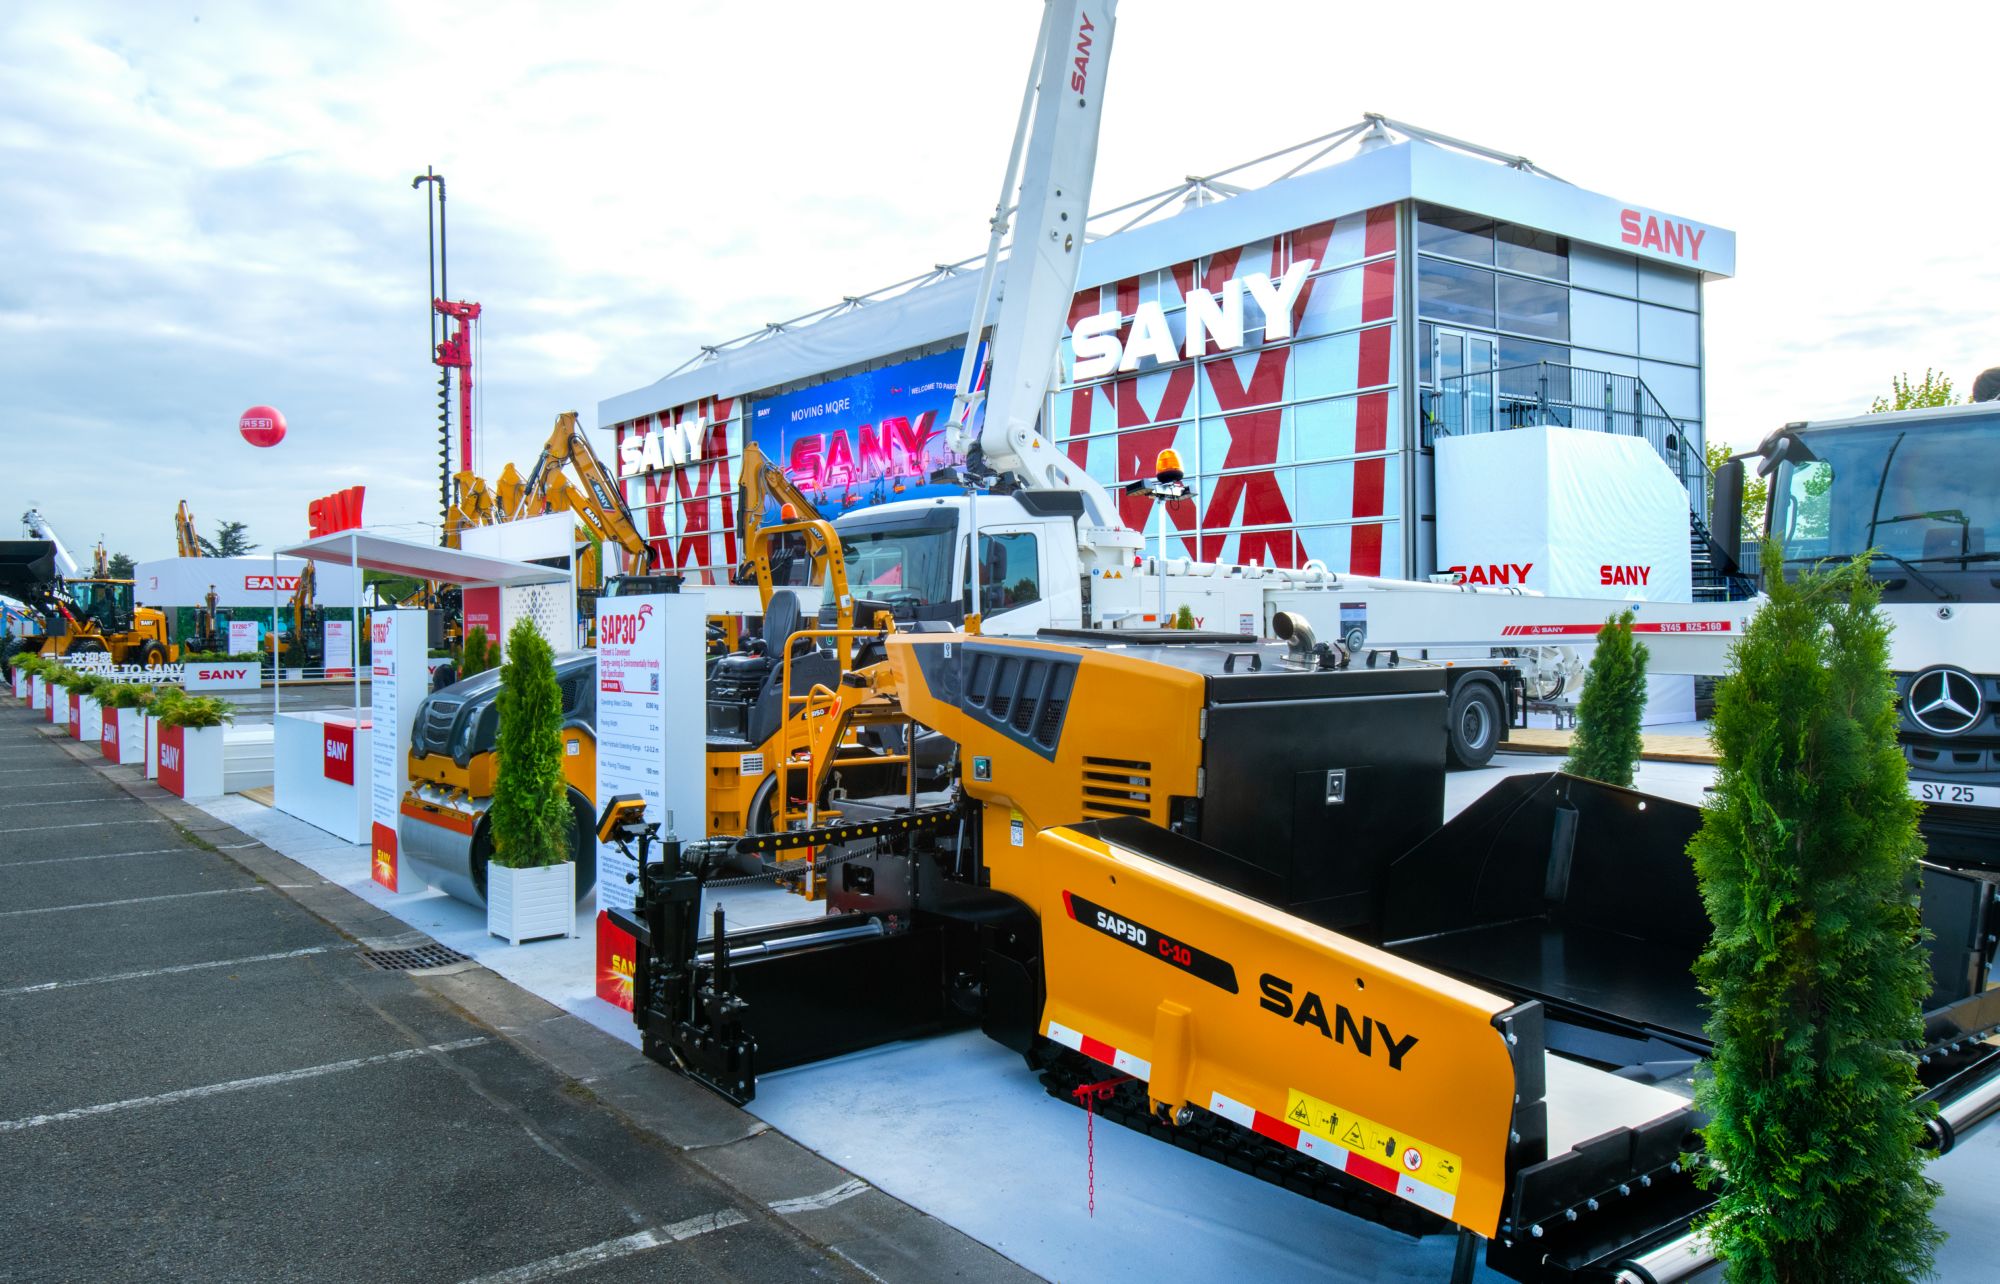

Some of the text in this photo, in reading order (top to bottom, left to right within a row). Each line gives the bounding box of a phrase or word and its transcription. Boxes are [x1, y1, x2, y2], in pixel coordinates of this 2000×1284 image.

[1071, 10, 1095, 96] SANY
[1620, 208, 1706, 261] SANY
[1071, 258, 1316, 381] SANY
[911, 383, 935, 395] WELCOME
[936, 382, 943, 390] TO
[791, 398, 850, 422] MOVING MORE
[621, 417, 707, 476] SANY
[790, 409, 938, 492] SANY
[594, 484, 610, 508] SANY
[308, 485, 366, 540] SANY
[247, 577, 299, 590] SANY
[1448, 563, 1534, 585] SANY
[1600, 565, 1651, 586] SANY
[53, 590, 74, 605] SANY
[601, 613, 636, 645] SAP30
[1660, 623, 1681, 632] SY45
[120, 664, 141, 674] TO
[144, 663, 184, 674] SANY
[198, 669, 248, 680] SANY
[160, 743, 180, 772] SANY
[326, 739, 348, 762] SANY
[1922, 784, 1975, 803] SY 25
[1096, 910, 1192, 968] SAP30 C-10
[612, 954, 636, 977] SAN
[1259, 972, 1419, 1071] SANY
